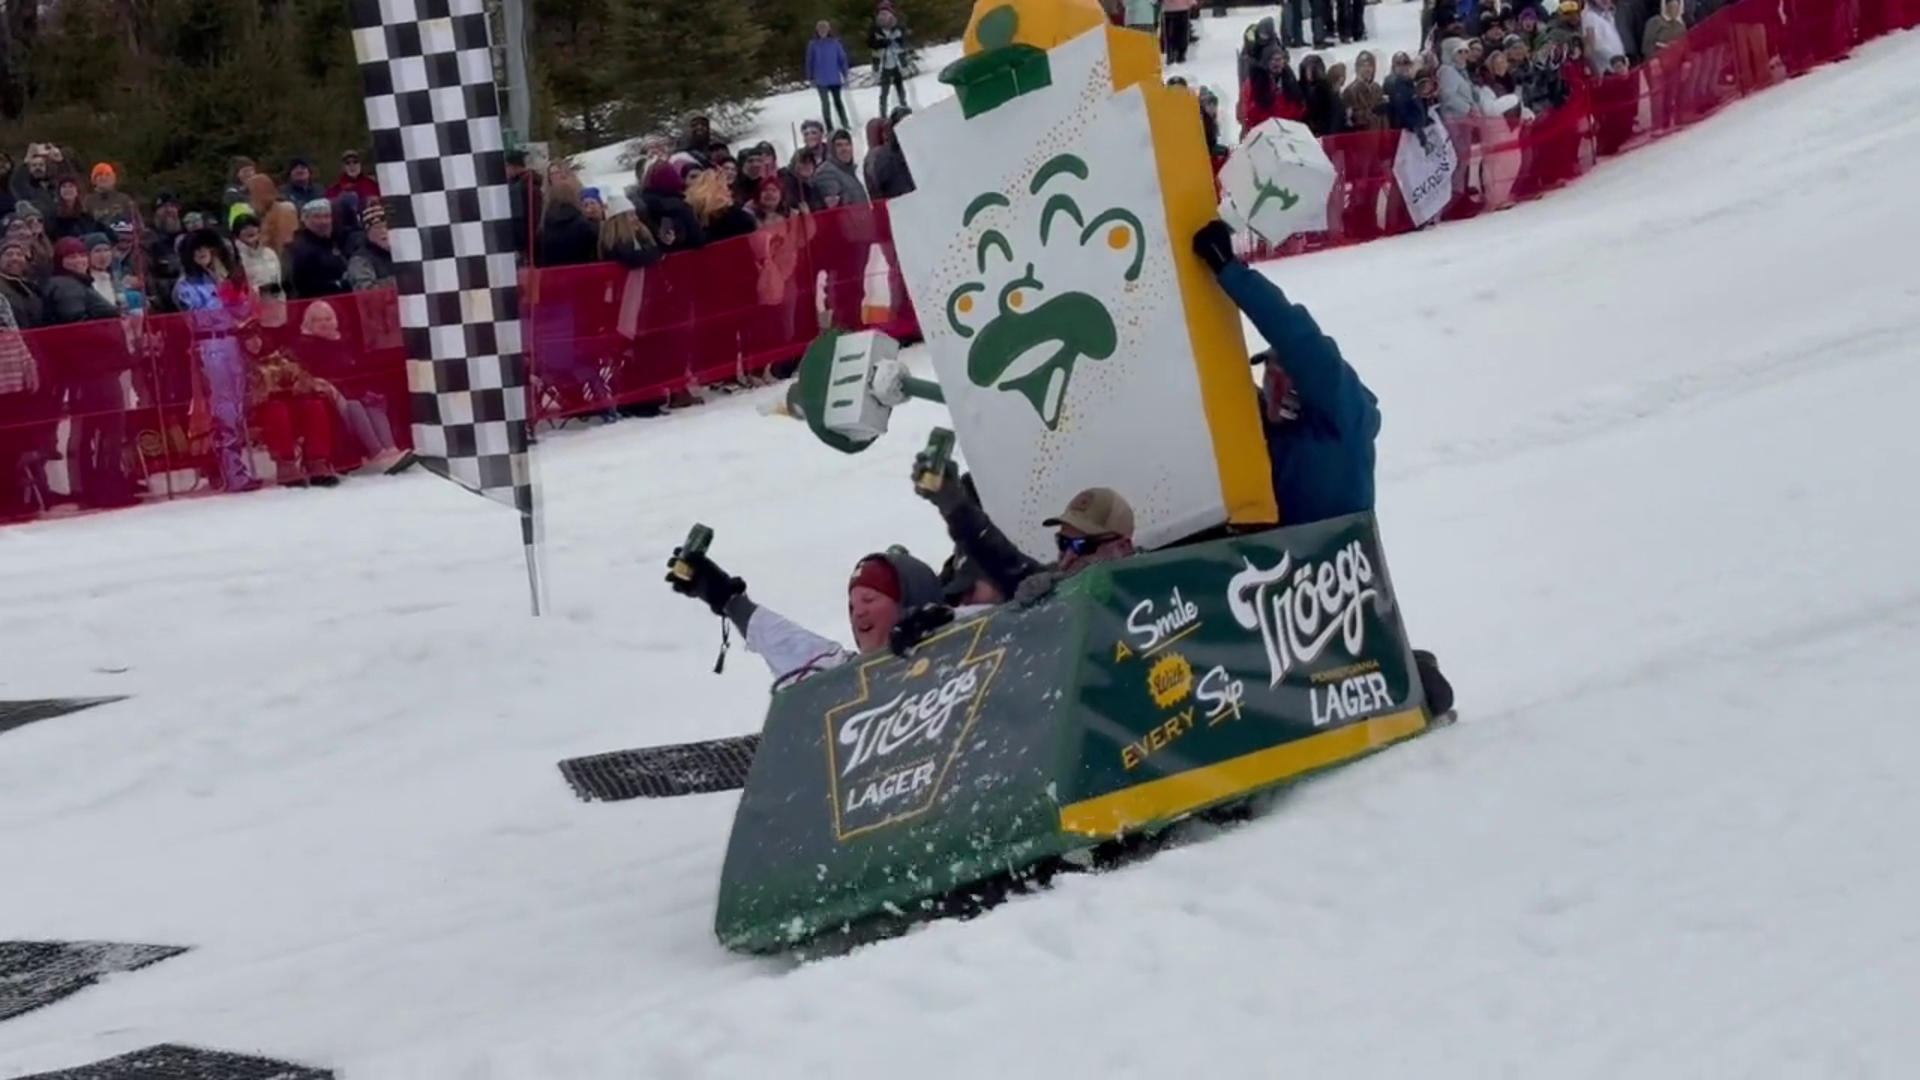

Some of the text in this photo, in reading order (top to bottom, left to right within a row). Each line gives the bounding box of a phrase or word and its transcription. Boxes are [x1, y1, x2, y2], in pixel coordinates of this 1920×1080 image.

[1114, 586, 1198, 663] A Smile
[1227, 540, 1377, 690] Tröegs
[1153, 662, 1185, 696] With
[1310, 671, 1394, 727] LAGER
[1120, 665, 1243, 770] EVERY Sip
[846, 760, 936, 812] LAGER
